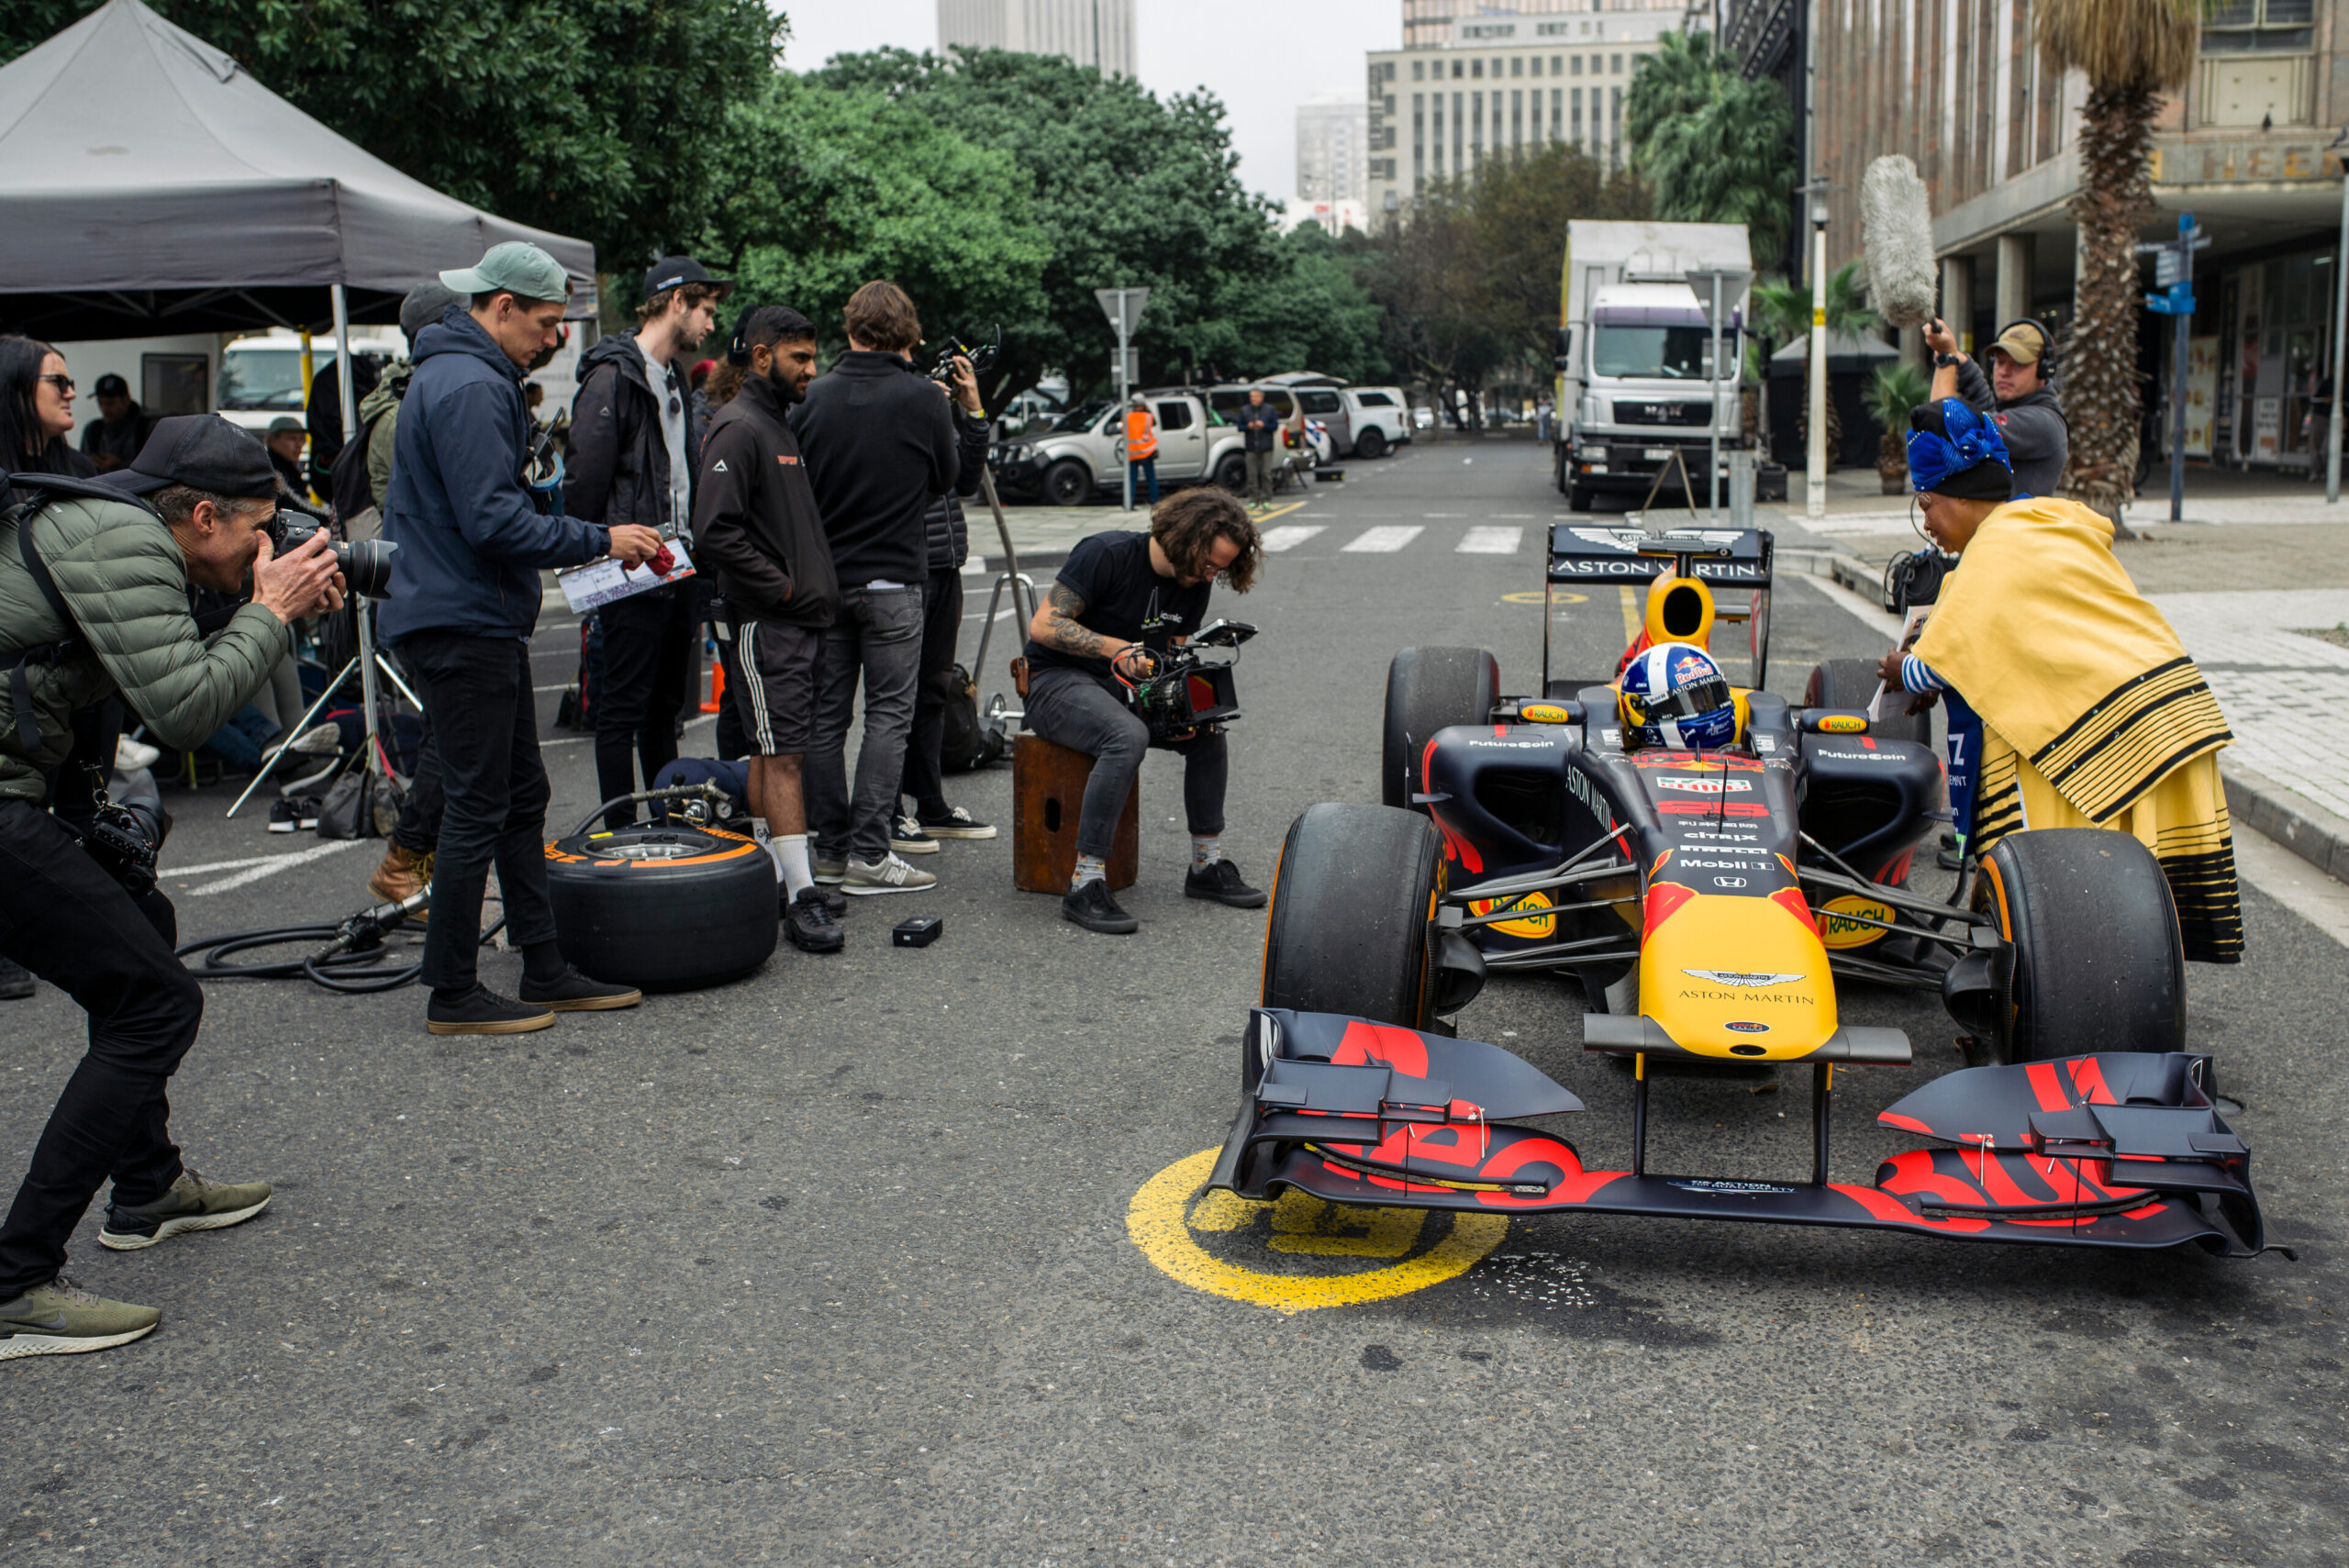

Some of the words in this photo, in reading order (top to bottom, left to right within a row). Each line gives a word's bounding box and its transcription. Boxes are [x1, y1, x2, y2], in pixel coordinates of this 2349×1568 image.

[1557, 560, 1650, 574] ASTON
[1655, 561, 1755, 576] MRTIN
[1672, 682, 1698, 695] ASTON
[1534, 708, 1564, 719] RAUCH
[1831, 720, 1861, 729] RAUCH
[1469, 740, 1554, 749] FuturoCoin
[1818, 749, 1906, 761] FuturoCoin
[1565, 763, 1590, 806] ASTON
[1590, 784, 1612, 834] MARTIN
[1679, 844, 1768, 854] PIRELLI
[1679, 859, 1747, 870] Mobil
[1493, 897, 1548, 928] RUCH
[1678, 990, 1735, 1001] ASTON
[1743, 994, 1814, 1006] MARTIN
